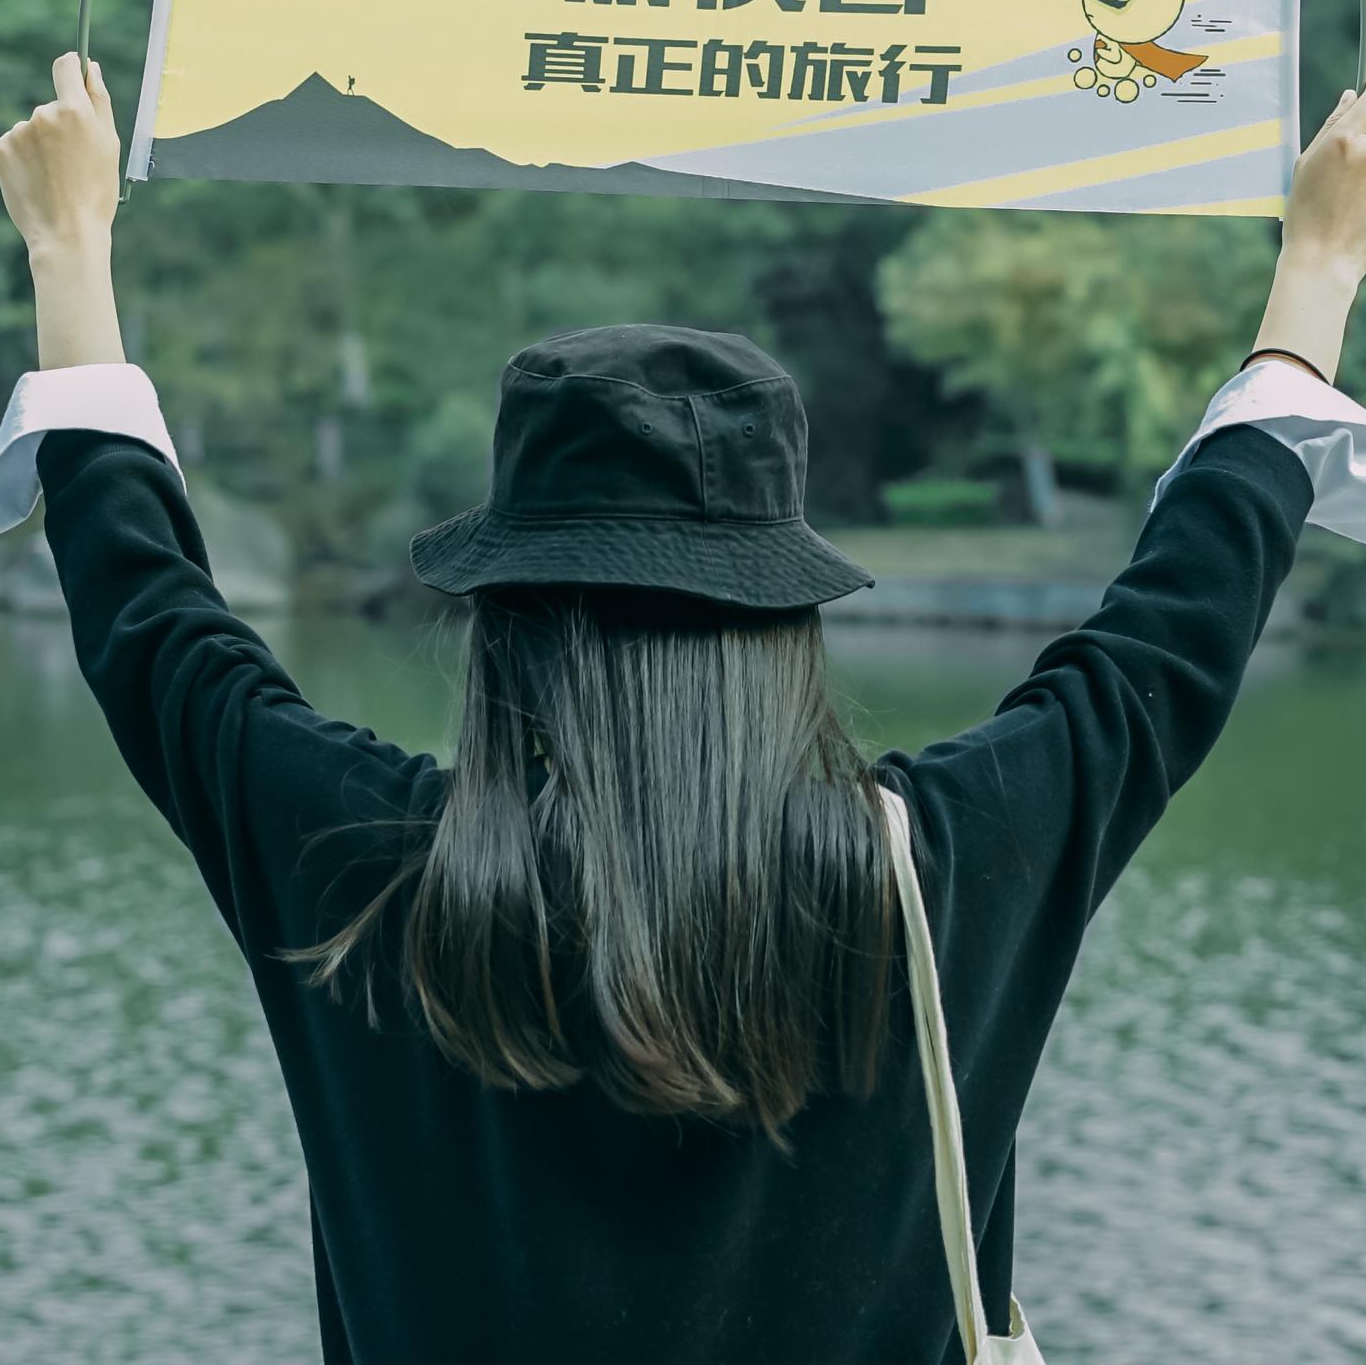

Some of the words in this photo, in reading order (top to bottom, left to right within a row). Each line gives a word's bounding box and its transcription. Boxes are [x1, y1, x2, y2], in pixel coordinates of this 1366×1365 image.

[521, 31, 962, 105] 真正的旅行
